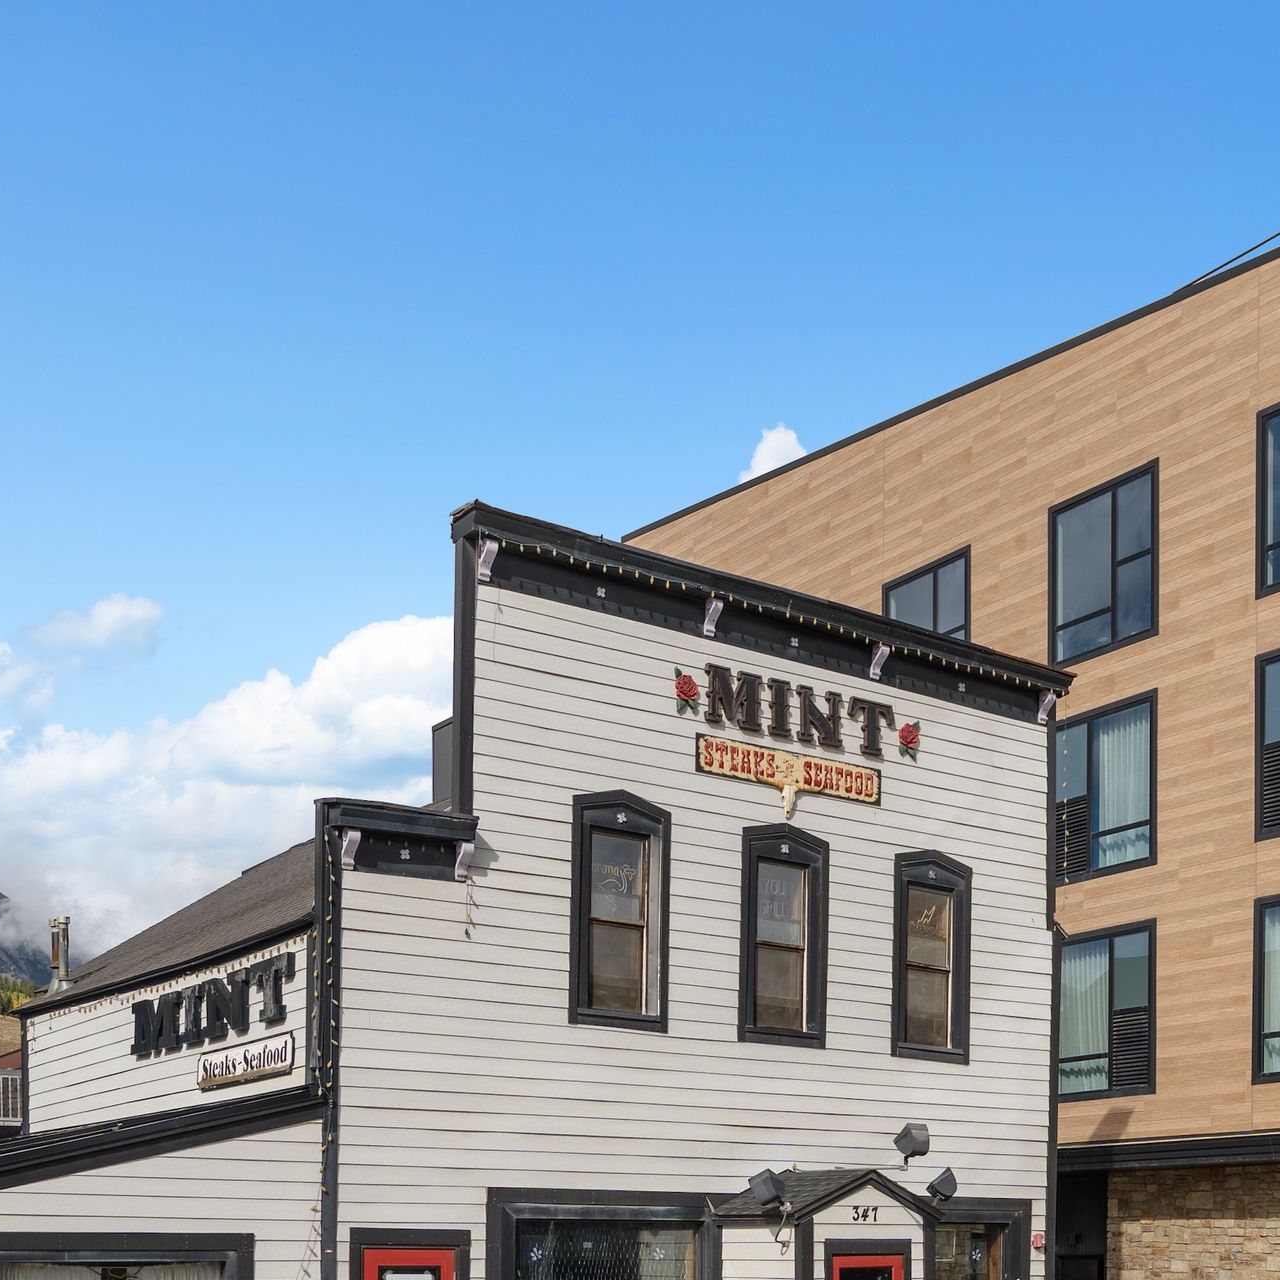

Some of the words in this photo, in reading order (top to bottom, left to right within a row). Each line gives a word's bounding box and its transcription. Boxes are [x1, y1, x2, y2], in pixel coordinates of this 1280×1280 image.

[704, 662, 895, 756] MINT
[704, 741, 776, 779] STEAKS
[803, 761, 875, 798] SEAFOOD
[130, 952, 295, 1055] MINT
[852, 1206, 878, 1222] 347
